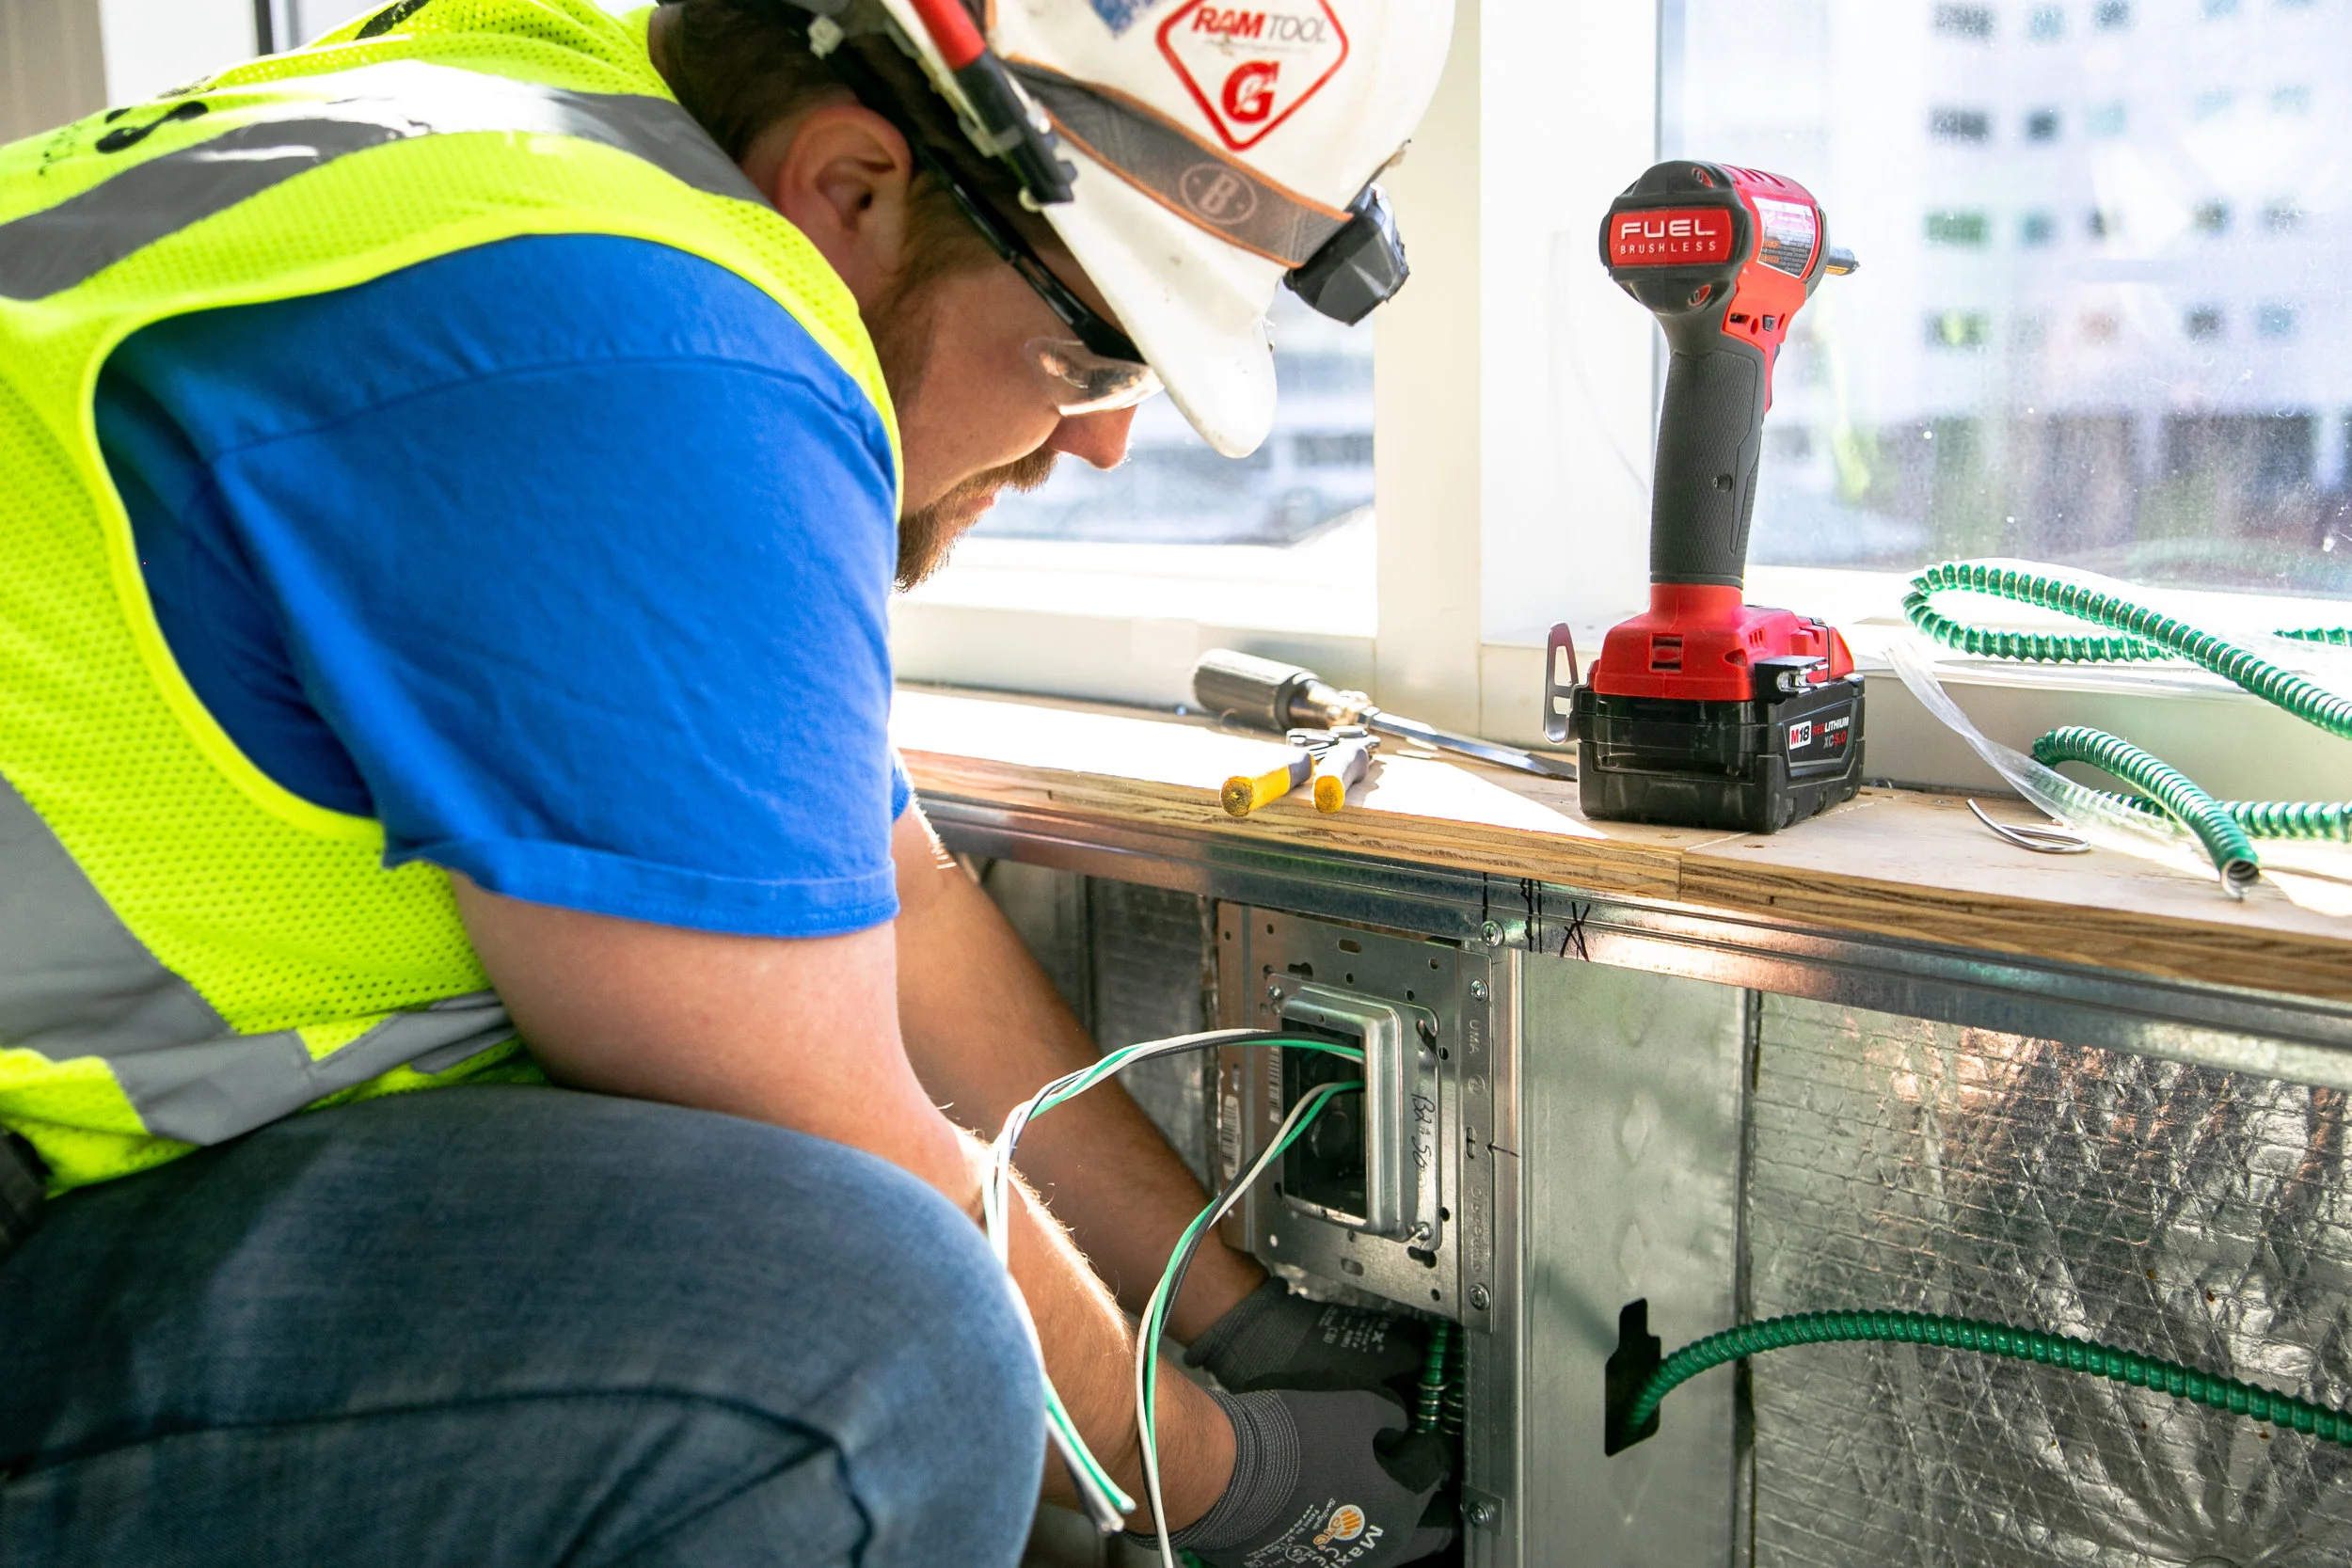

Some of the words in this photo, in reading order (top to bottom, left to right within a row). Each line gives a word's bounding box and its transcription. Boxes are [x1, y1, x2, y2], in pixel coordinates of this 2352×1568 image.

[1191, 7, 1267, 39] RAM
[1267, 14, 1328, 43] TOOL
[1220, 60, 1280, 124] G
[1199, 173, 1239, 214] B
[1621, 218, 1717, 240] FUEL
[1620, 241, 1716, 255] BRUSHLESS
[1790, 725, 1810, 746] M18
[1823, 731, 1847, 749] XC5.0
